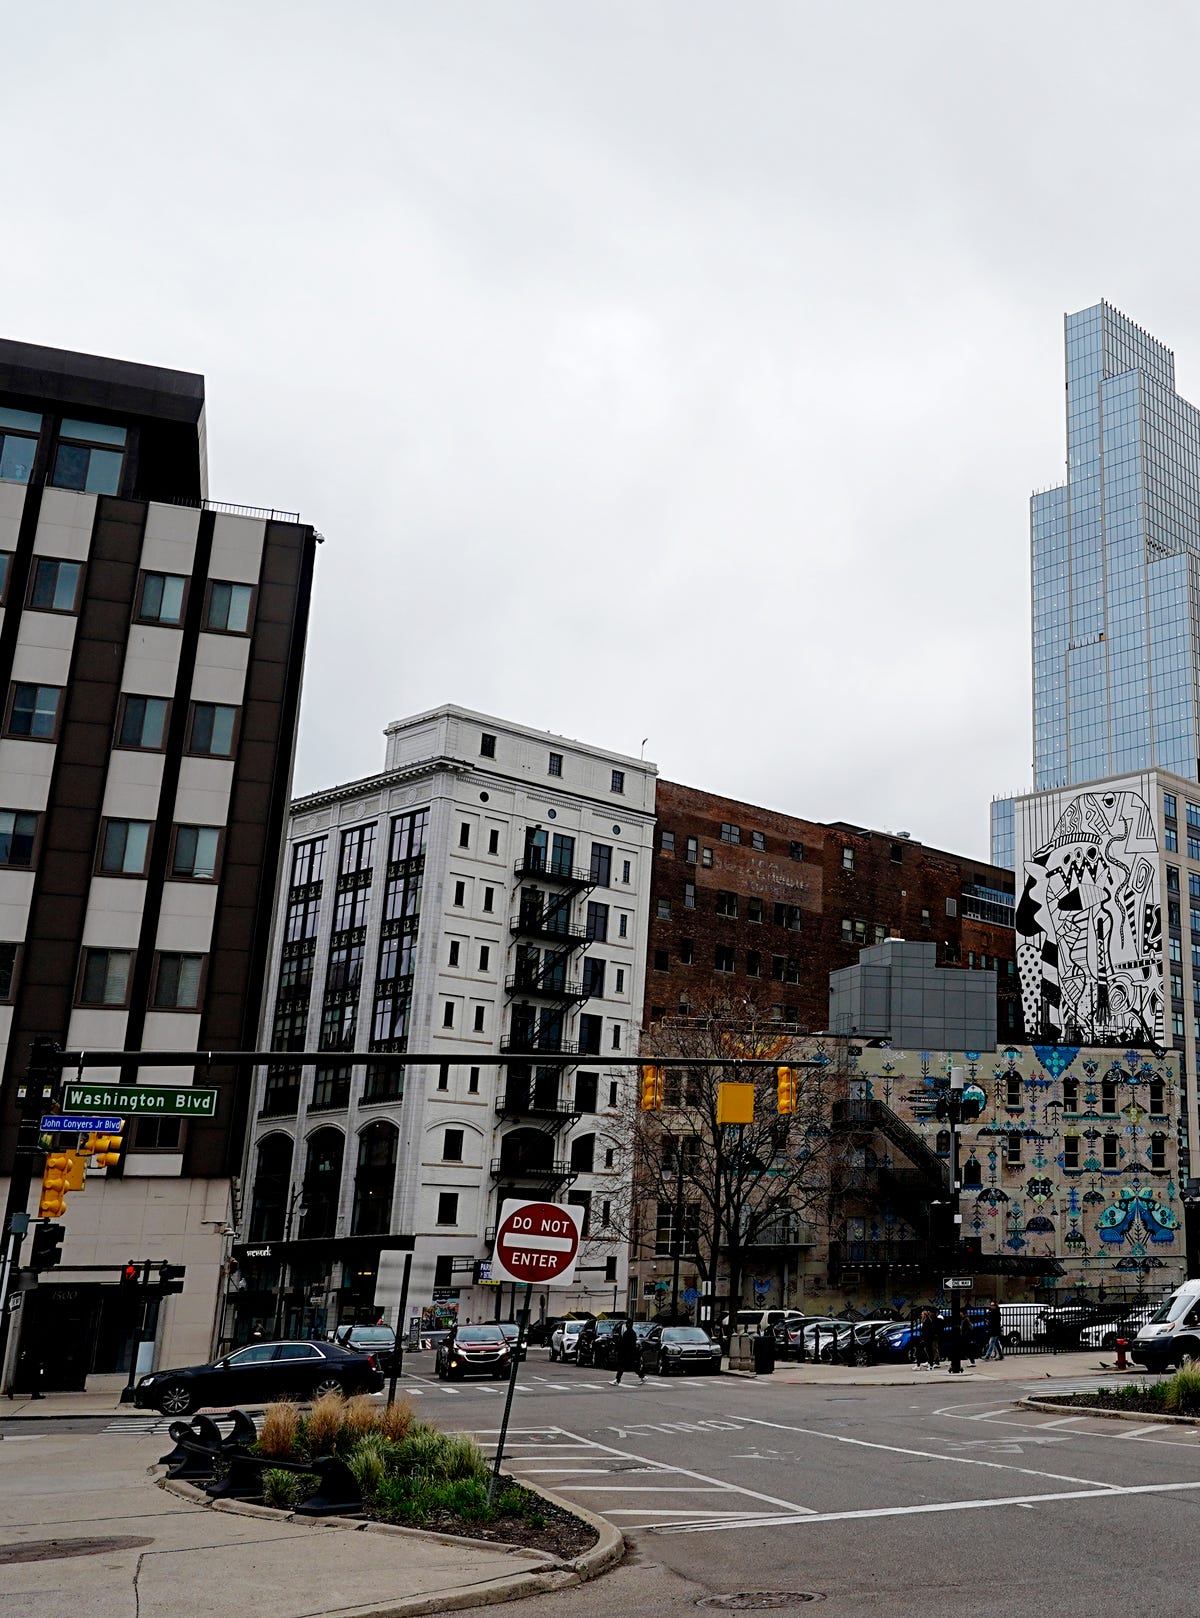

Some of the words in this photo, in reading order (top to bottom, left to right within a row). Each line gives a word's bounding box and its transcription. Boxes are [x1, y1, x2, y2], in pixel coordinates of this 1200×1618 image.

[70, 1090, 165, 1111] Washington
[175, 1094, 212, 1110] Blvd
[42, 1118, 61, 1129] John
[62, 1119, 94, 1131] Conyers
[94, 1120, 104, 1129] Jr
[104, 1120, 121, 1131] Blvd
[512, 1216, 533, 1230] DO
[540, 1219, 570, 1233] NOT
[246, 1245, 272, 1257] wework
[511, 1252, 558, 1268] ENTER
